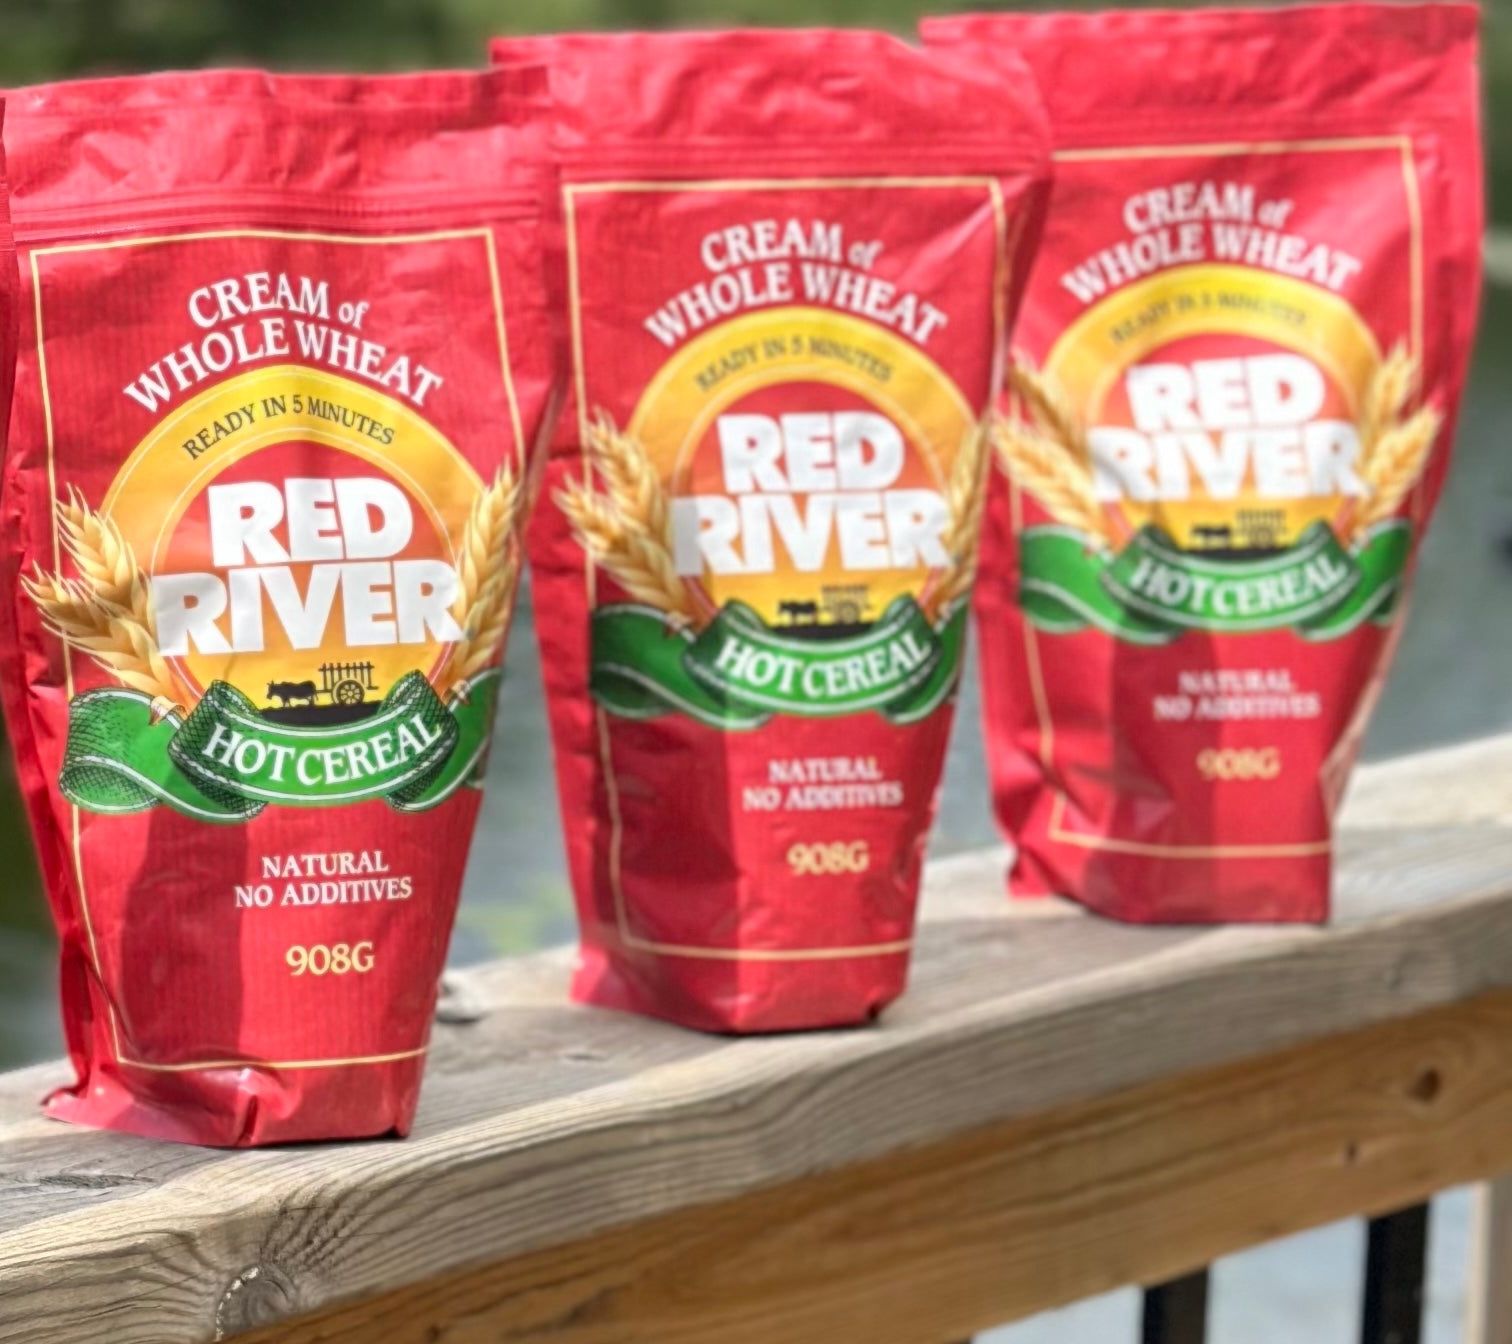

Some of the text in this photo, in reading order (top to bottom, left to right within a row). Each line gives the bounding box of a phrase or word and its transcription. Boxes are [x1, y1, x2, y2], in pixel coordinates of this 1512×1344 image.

[1123, 181, 1293, 234] CREAM of
[700, 218, 883, 272] CREAM of
[1060, 223, 1362, 304] WHOLE WHEAT
[188, 271, 369, 329] CREAM of
[644, 261, 948, 349] WHOLE WHEAT
[124, 318, 442, 414] WHOLE WHEAT
[695, 336, 893, 394] READY IN 5 MINUTES
[1126, 353, 1325, 431] RED
[182, 394, 396, 461] READY IN 5 MINUTES
[717, 411, 905, 493] RED
[1088, 420, 1372, 502] RIVER
[208, 477, 413, 567] RED
[669, 488, 957, 577] RIVER
[150, 559, 466, 656] RIVER
[1129, 554, 1347, 618] HOT CEREAL
[714, 631, 931, 698] HOT CEREAL
[201, 714, 442, 786] HOT CEREAL
[768, 758, 882, 783] NATURAL
[742, 781, 902, 810] NO ADDITIVES
[261, 851, 389, 878] NATURAL
[788, 841, 869, 875] 908G
[235, 876, 413, 908] NO ADDITIVES
[286, 941, 375, 976] 908G
